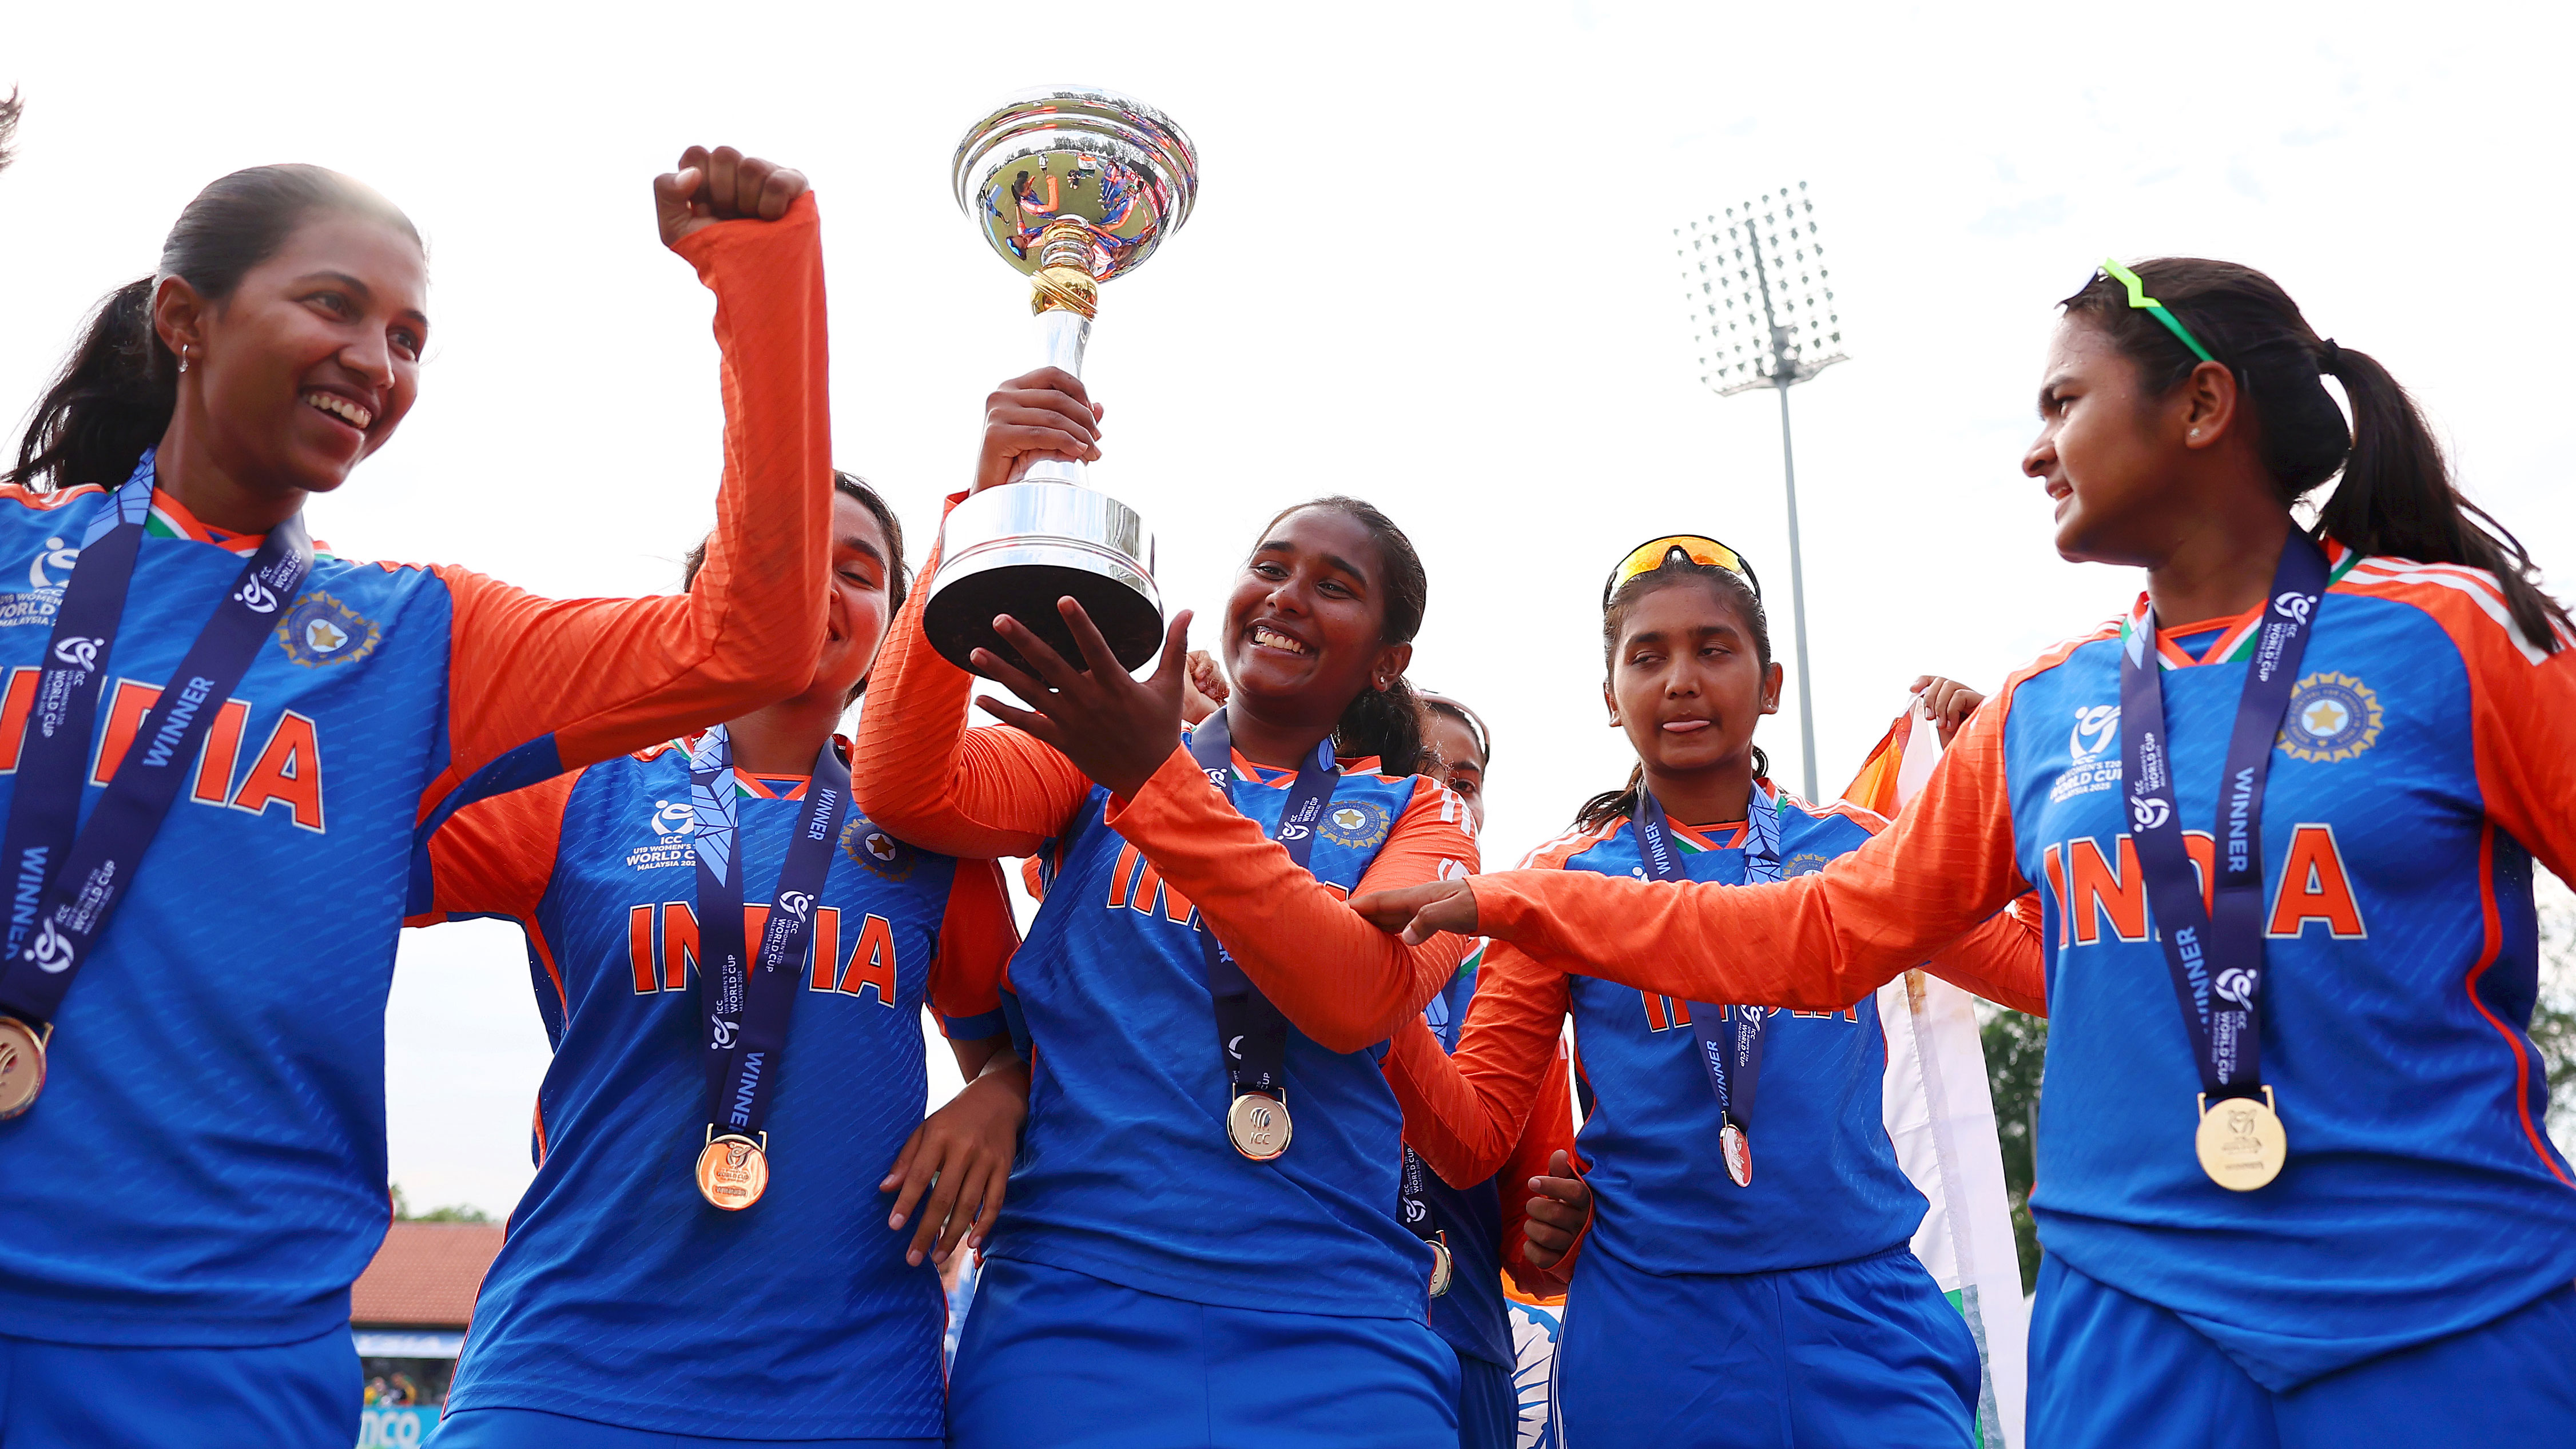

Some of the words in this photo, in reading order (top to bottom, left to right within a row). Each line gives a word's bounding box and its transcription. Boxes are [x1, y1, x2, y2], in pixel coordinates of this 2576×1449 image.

[16, 592, 63, 606] WOMEN
[47, 670, 67, 711] WORLD
[42, 712, 57, 737] CUP
[142, 676, 215, 767] WINNER
[807, 788, 837, 841] WINNER
[1302, 806, 1315, 822] WORLD
[1310, 797, 1319, 806] CUP
[2228, 766, 2255, 873] WINNER
[633, 846, 648, 854] U19
[649, 843, 692, 852] WOMEN'S
[660, 835, 683, 845] ICC
[1644, 821, 1671, 875] WINNER
[626, 850, 681, 866] WORLD
[637, 861, 679, 871] MALAYSIA
[2043, 822, 2368, 950] INA
[767, 917, 778, 942] MALAYSIA
[771, 918, 786, 952] WORLD
[790, 921, 800, 934] ICC
[728, 954, 736, 974] CUP
[766, 953, 777, 972] CUP
[2175, 926, 2210, 1035] INNER
[729, 976, 738, 1013] WORLD
[1706, 1040, 1730, 1106] WINNER
[1250, 1131, 1271, 1144] ICC
[1410, 1164, 1420, 1193] WORLD
